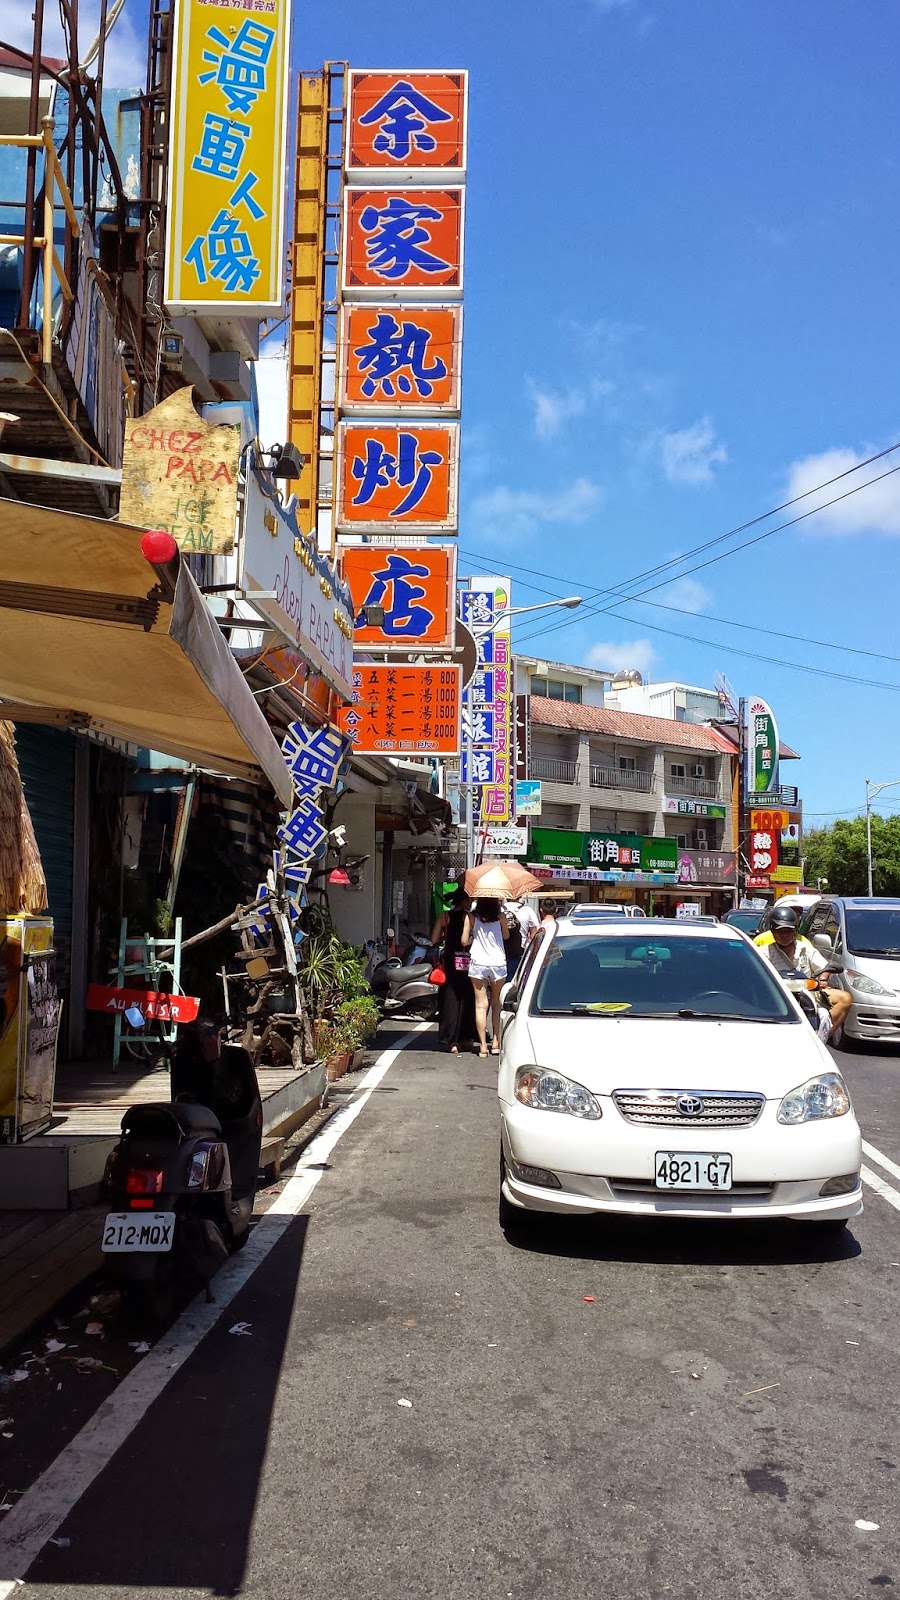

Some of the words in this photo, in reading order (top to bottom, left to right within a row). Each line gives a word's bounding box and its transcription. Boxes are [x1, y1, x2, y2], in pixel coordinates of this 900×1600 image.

[351, 80, 455, 638] 余家熱炒店
[129, 427, 203, 453] CHEZ
[165, 455, 234, 486] PAPA
[141, 522, 214, 551] EAM
[368, 669, 433, 686] 五菜一湯
[441, 671, 456, 685] 800
[367, 687, 433, 703] 六菜一湯
[435, 688, 455, 702] 1000
[366, 704, 432, 720] 七菜一湯
[435, 705, 455, 719] 1500
[366, 722, 432, 738] 八菜一湯
[434, 724, 455, 738] 2000
[754, 717, 771, 770] 街角旅店
[753, 811, 783, 829] 100
[589, 838, 641, 865] 街角旅店
[649, 859, 676, 868] 08-8861181
[753, 832, 772, 869] 熱炒
